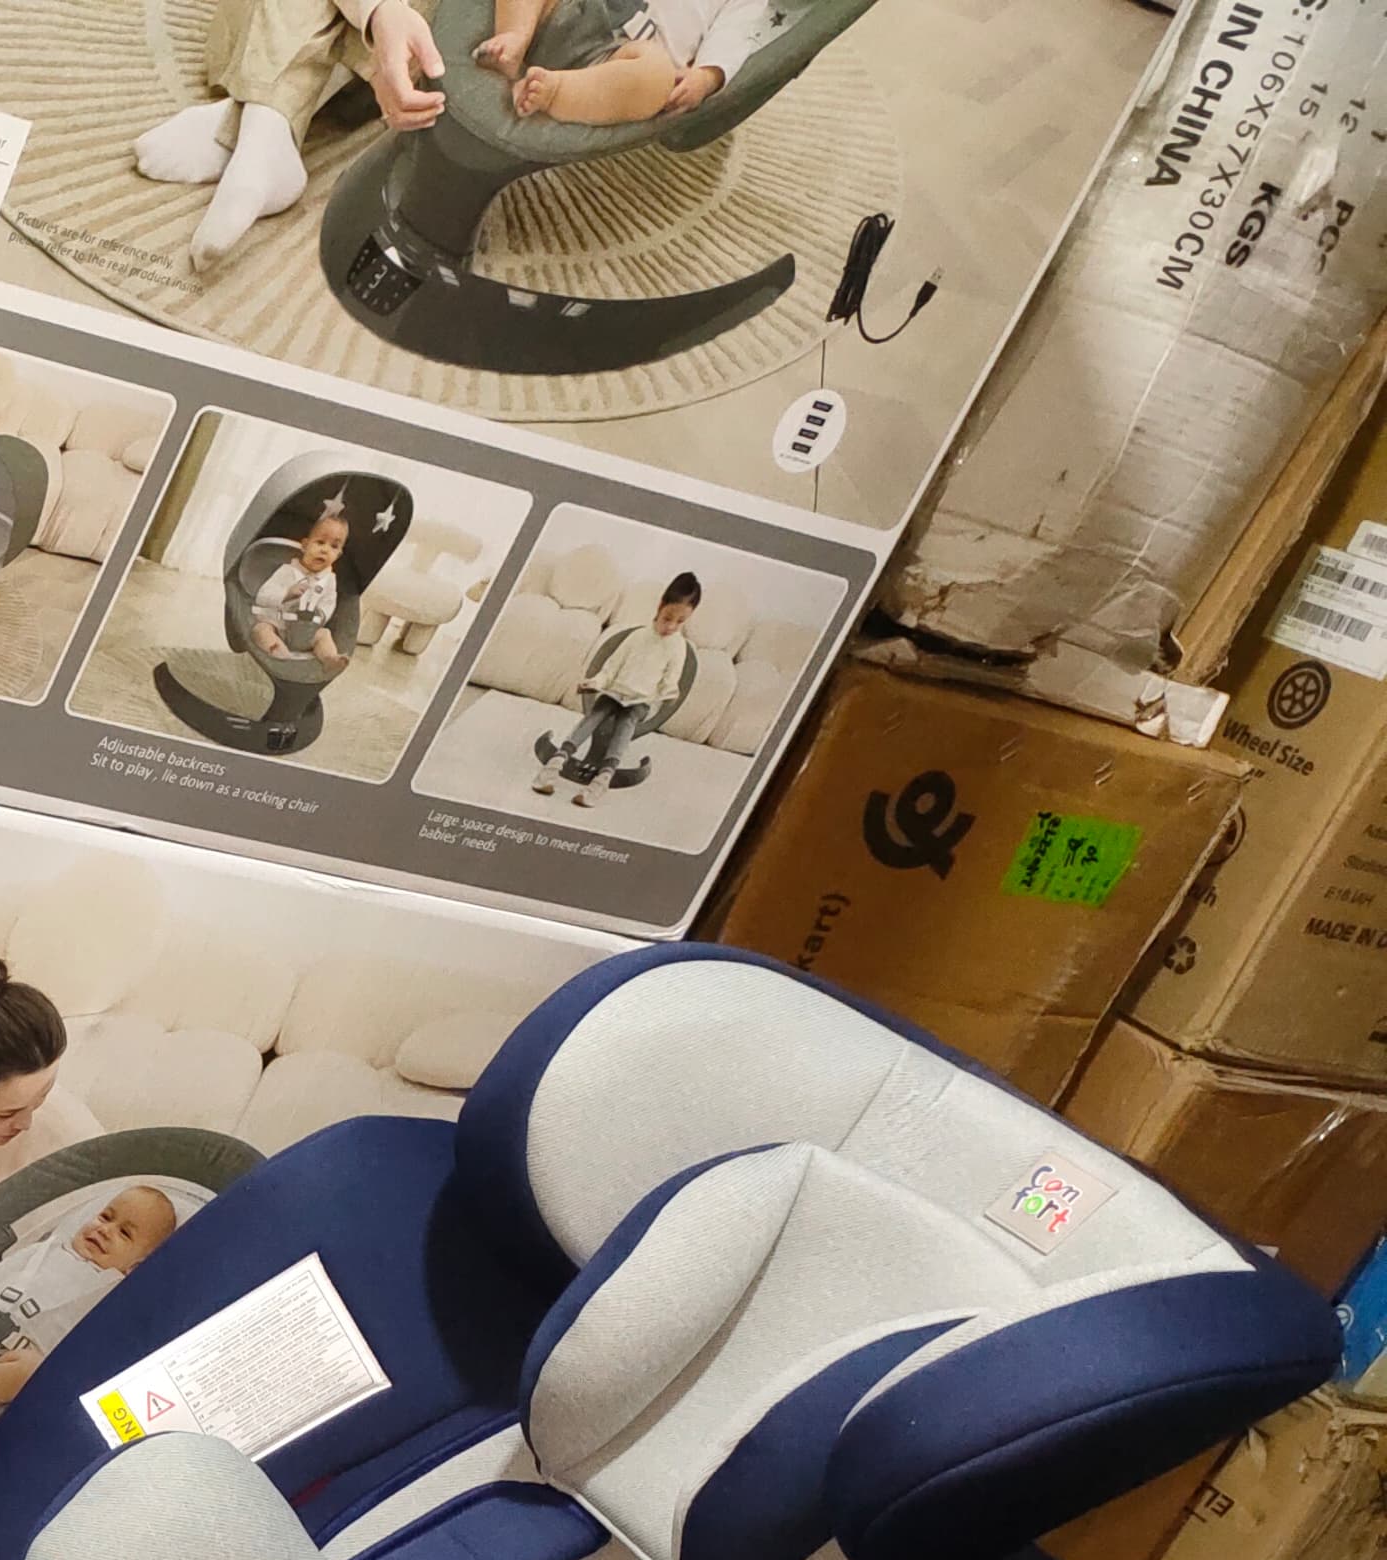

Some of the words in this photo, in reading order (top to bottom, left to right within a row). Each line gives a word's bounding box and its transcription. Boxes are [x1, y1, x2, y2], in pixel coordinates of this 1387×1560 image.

[1218, 3, 1264, 52] IN
[1144, 59, 1235, 187] CHINA
[1155, 33, 1307, 291] 106X57X30CM
[16, 211, 59, 235] Pictures
[61, 227, 78, 241] are
[80, 230, 96, 246] for
[98, 238, 148, 261] reference
[1224, 181, 1283, 270] KGS
[46, 241, 71, 257] refer
[74, 250, 86, 264] to
[87, 251, 106, 268] the
[107, 259, 127, 273] real
[129, 266, 171, 286] product
[97, 735, 166, 763] Adjustable
[167, 753, 227, 777] backrests
[1222, 719, 1279, 757] Wheel
[1277, 745, 1314, 776] Size
[90, 753, 108, 768] Sit
[109, 757, 124, 772] to
[161, 769, 177, 784] lie
[179, 773, 215, 794] down
[216, 783, 231, 796] as
[232, 787, 242, 799] a
[242, 789, 288, 810] rocking
[288, 797, 320, 814] chair
[427, 809, 459, 828] Large
[460, 817, 495, 837] space
[495, 824, 533, 843] design
[535, 833, 549, 845] to
[550, 838, 581, 854] meet
[580, 843, 630, 864] different
[462, 836, 498, 853] needs
[1304, 917, 1356, 942] MADE
